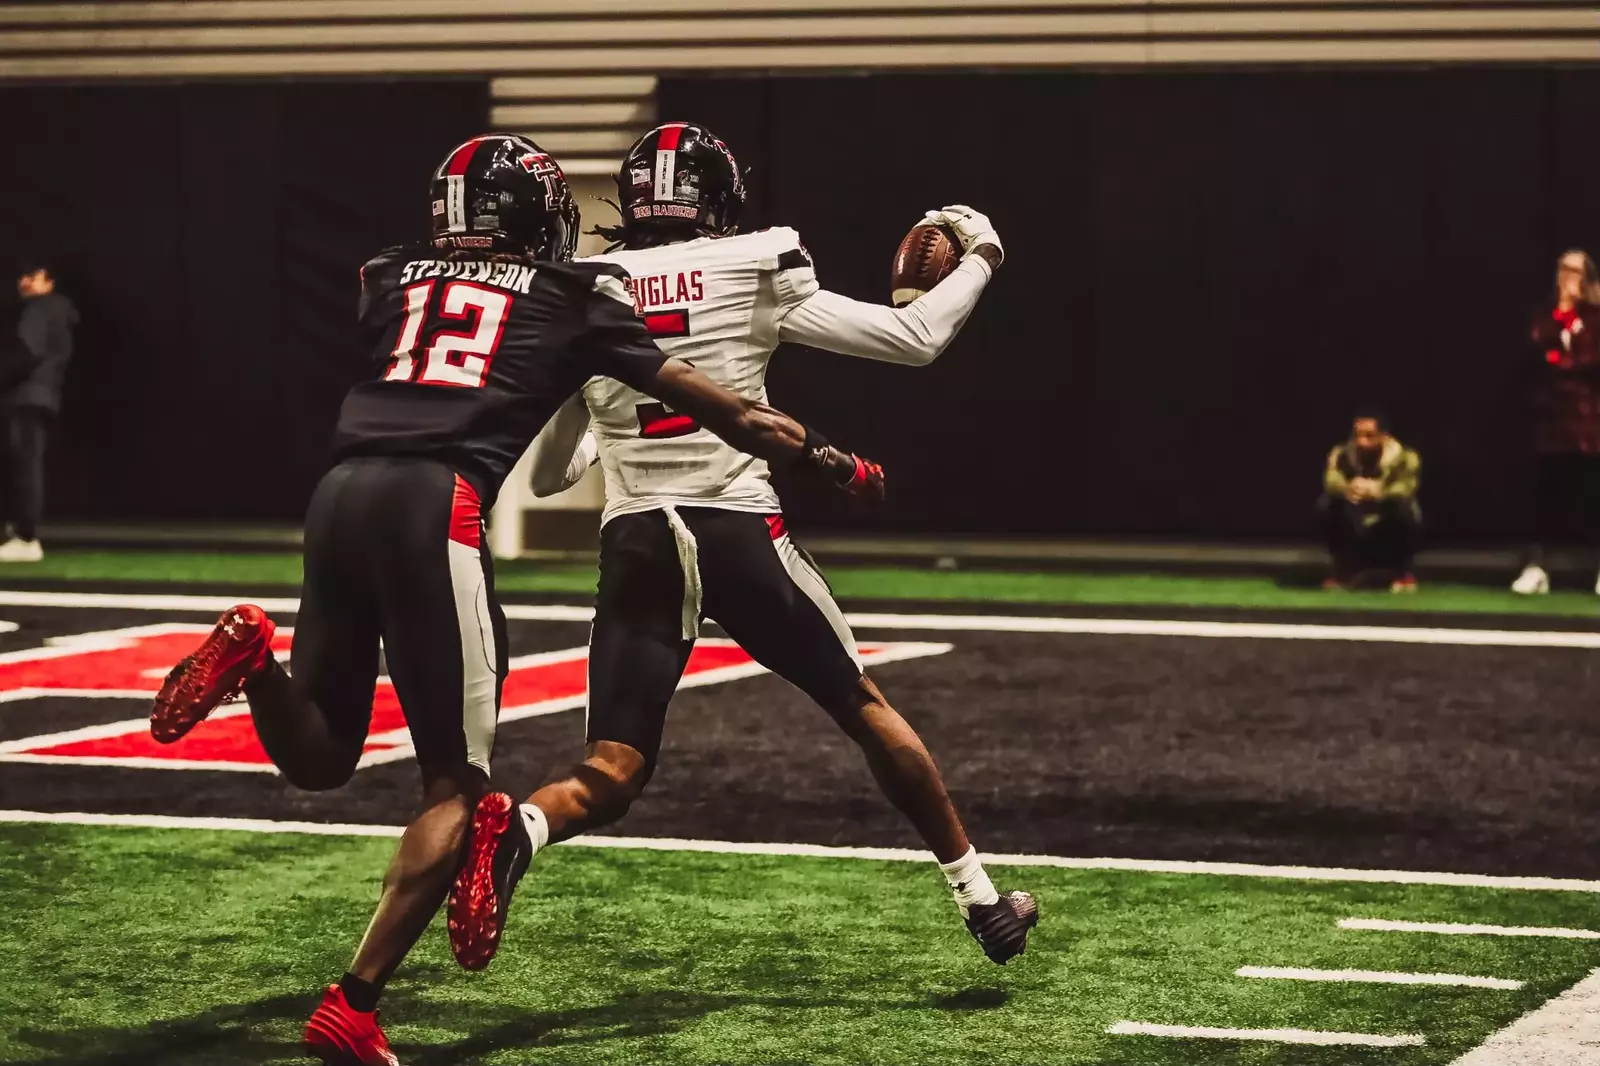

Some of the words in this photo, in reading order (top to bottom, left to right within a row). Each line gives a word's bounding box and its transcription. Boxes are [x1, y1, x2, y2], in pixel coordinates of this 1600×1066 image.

[399, 259, 537, 294] STEVENSON
[631, 270, 704, 308] UGLAS
[384, 278, 515, 389] 12
